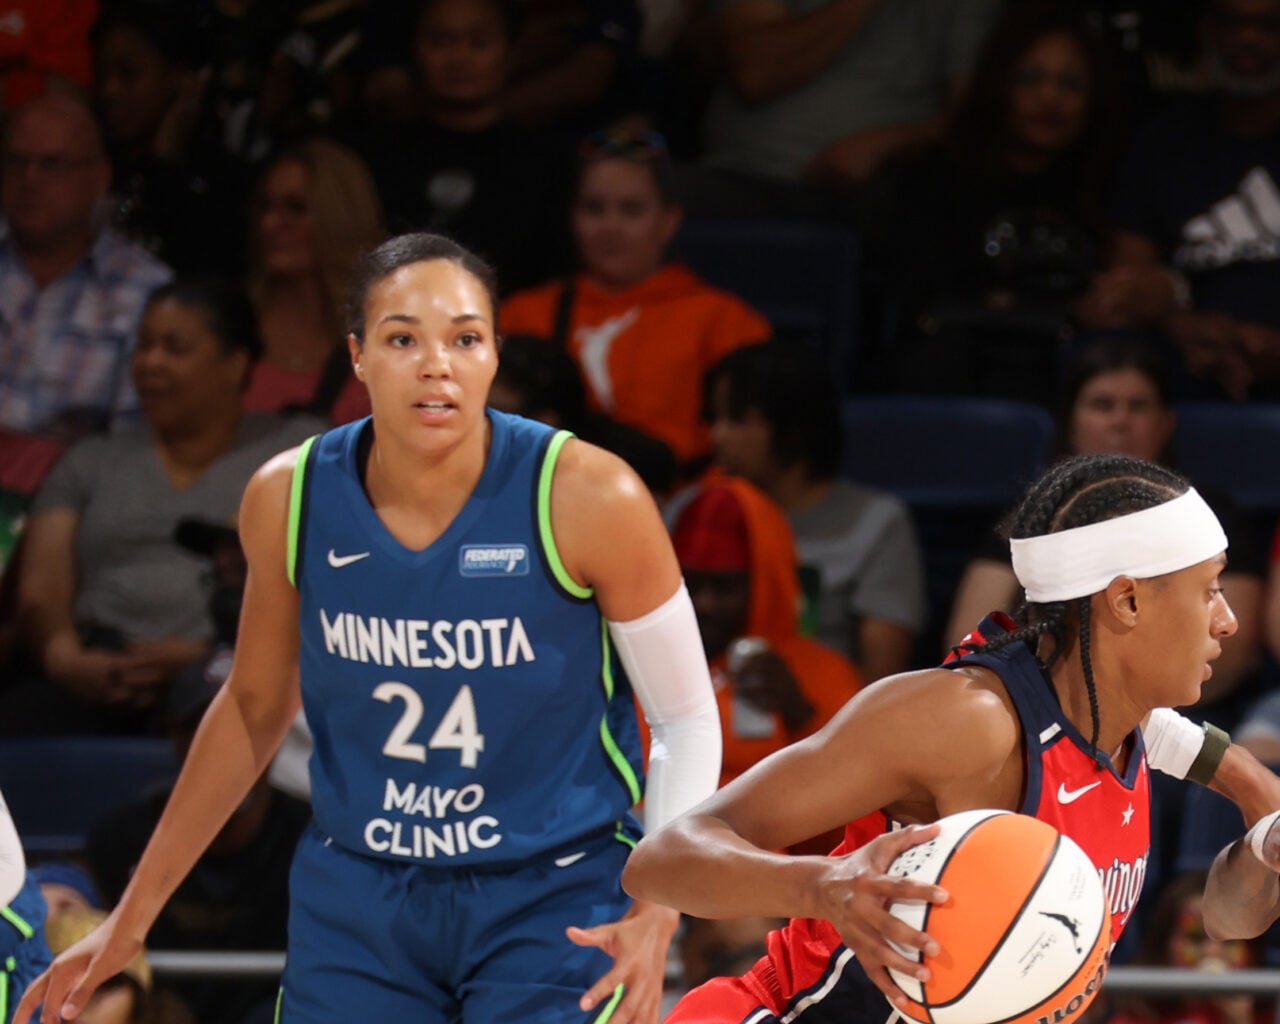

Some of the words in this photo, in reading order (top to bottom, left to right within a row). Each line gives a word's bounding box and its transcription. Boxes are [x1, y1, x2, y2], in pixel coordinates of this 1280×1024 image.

[464, 548, 525, 561] FEDERATED
[320, 608, 536, 669] MINNESOTA
[373, 681, 485, 769] 24
[383, 778, 485, 818] MAYO
[364, 816, 502, 858] CLINIC
